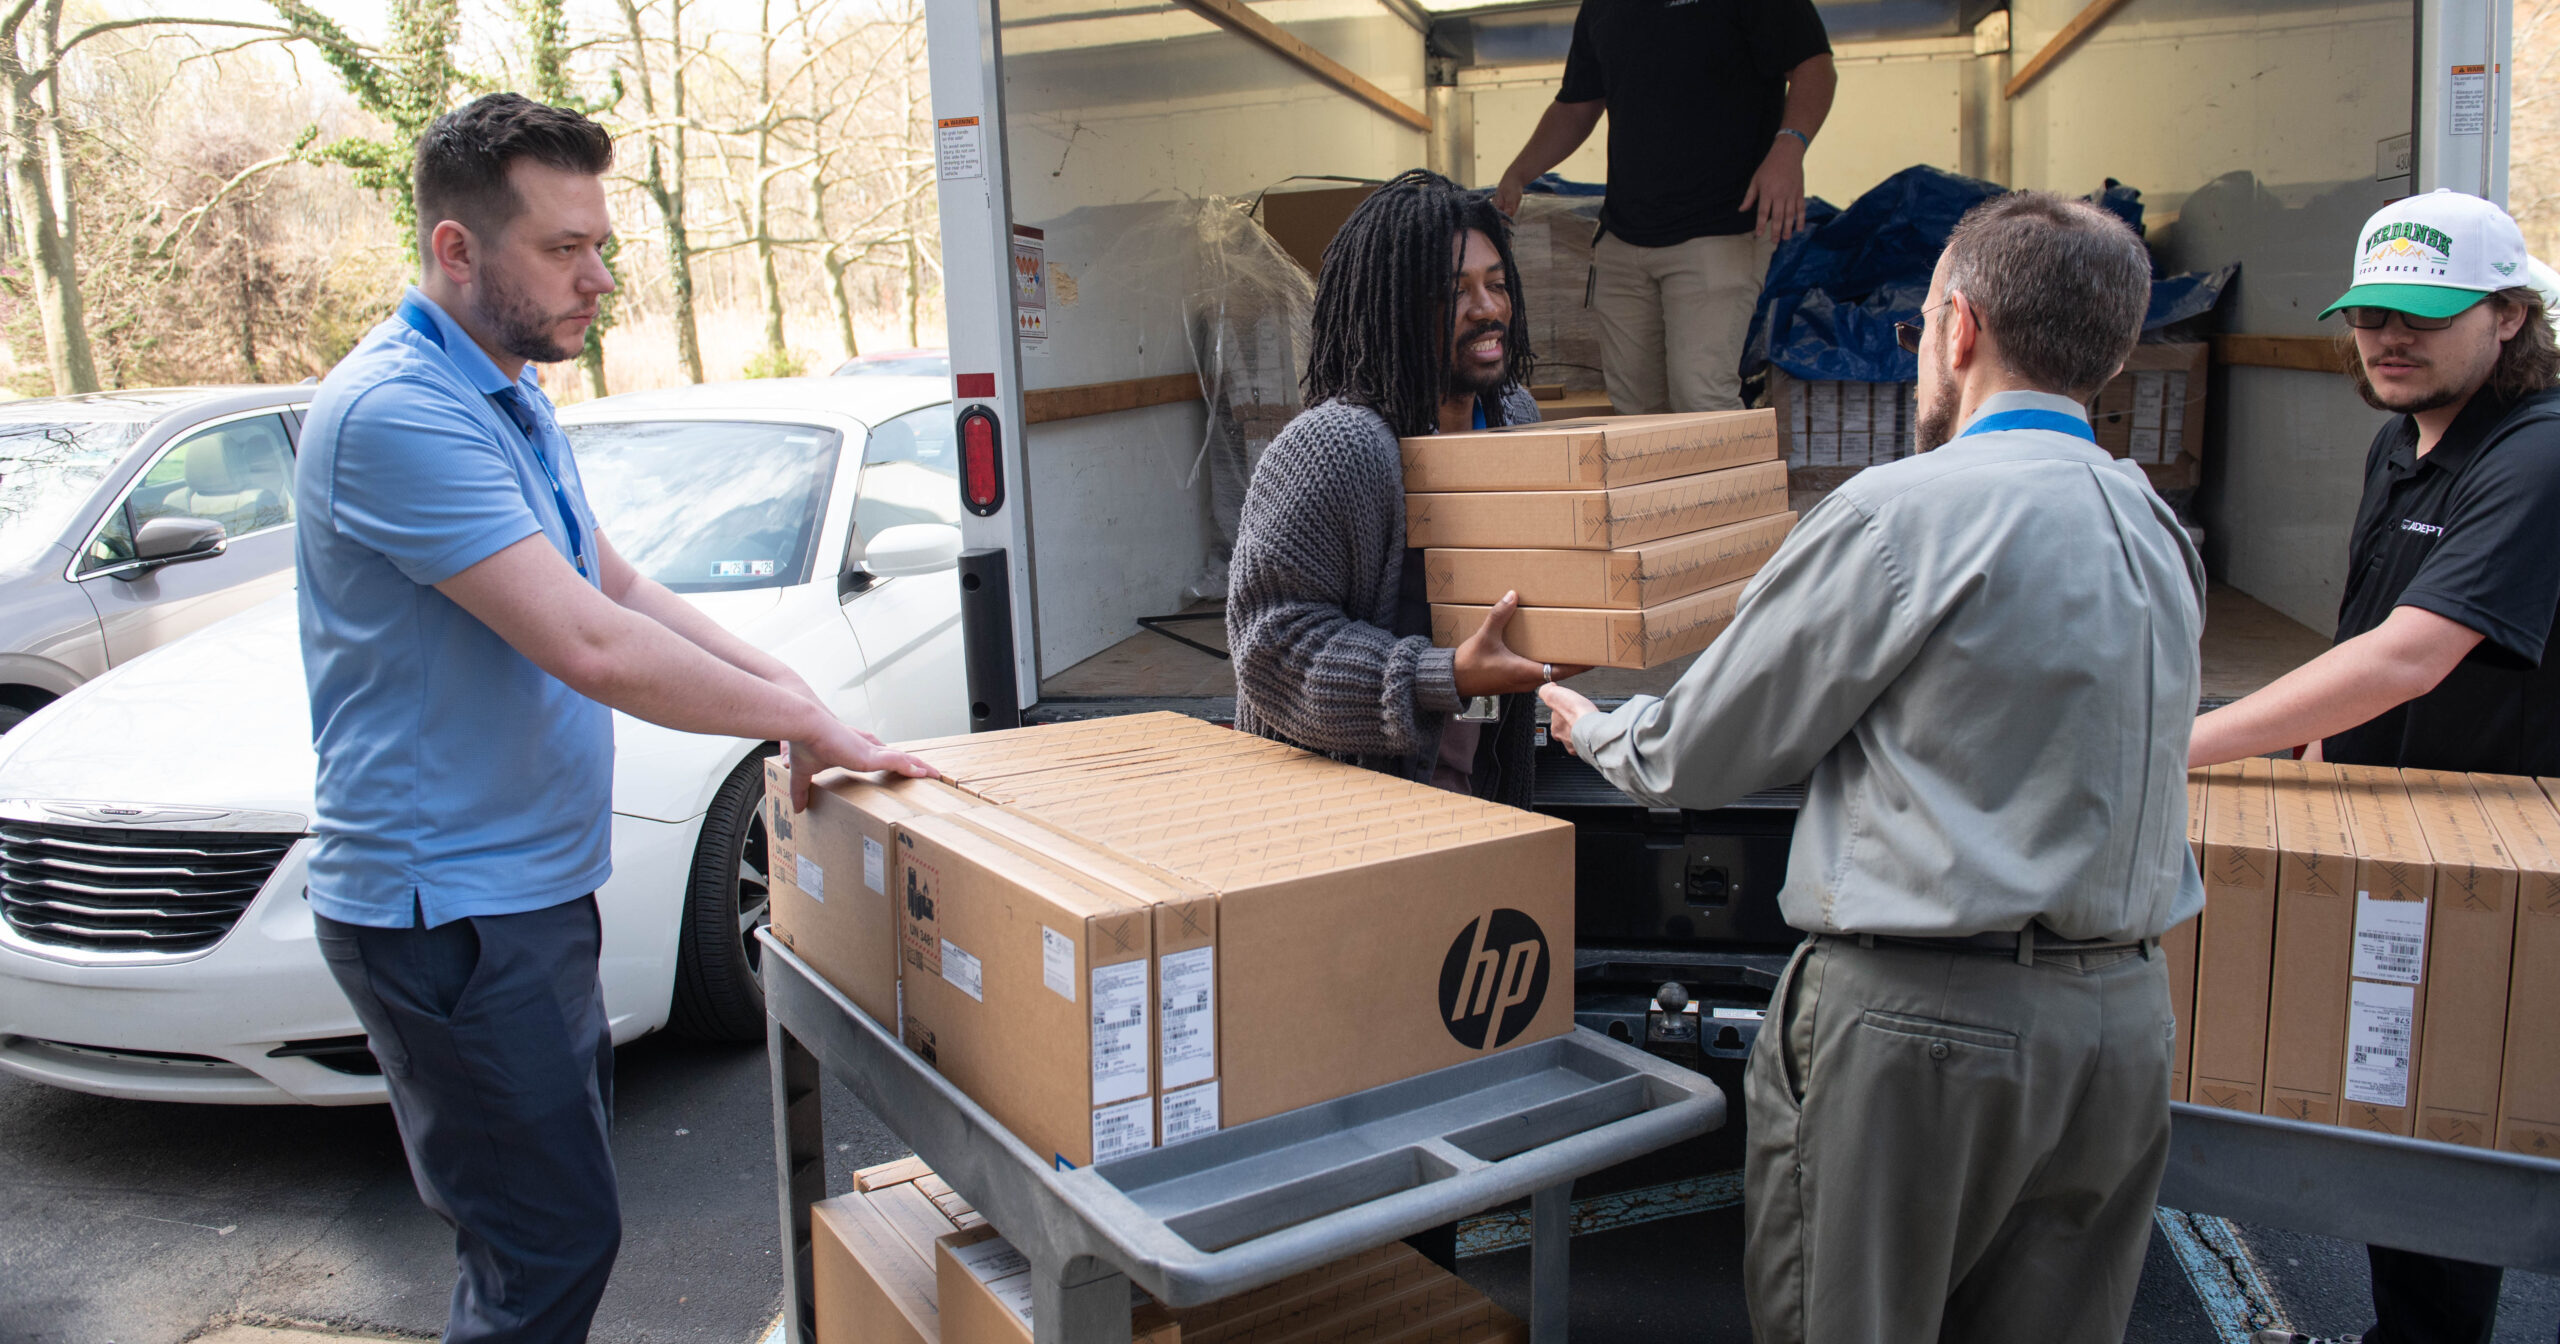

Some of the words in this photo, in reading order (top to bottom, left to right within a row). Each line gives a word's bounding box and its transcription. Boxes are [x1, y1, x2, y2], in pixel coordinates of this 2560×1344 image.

[2365, 222, 2453, 257] VERDANSK
[2386, 265, 2419, 273] BACK
[2431, 267, 2445, 276] IN
[2408, 521, 2444, 537] ADEPT
[909, 923, 920, 939] UN
[920, 929, 934, 949] 3481
[1451, 909, 1541, 1050] hp
